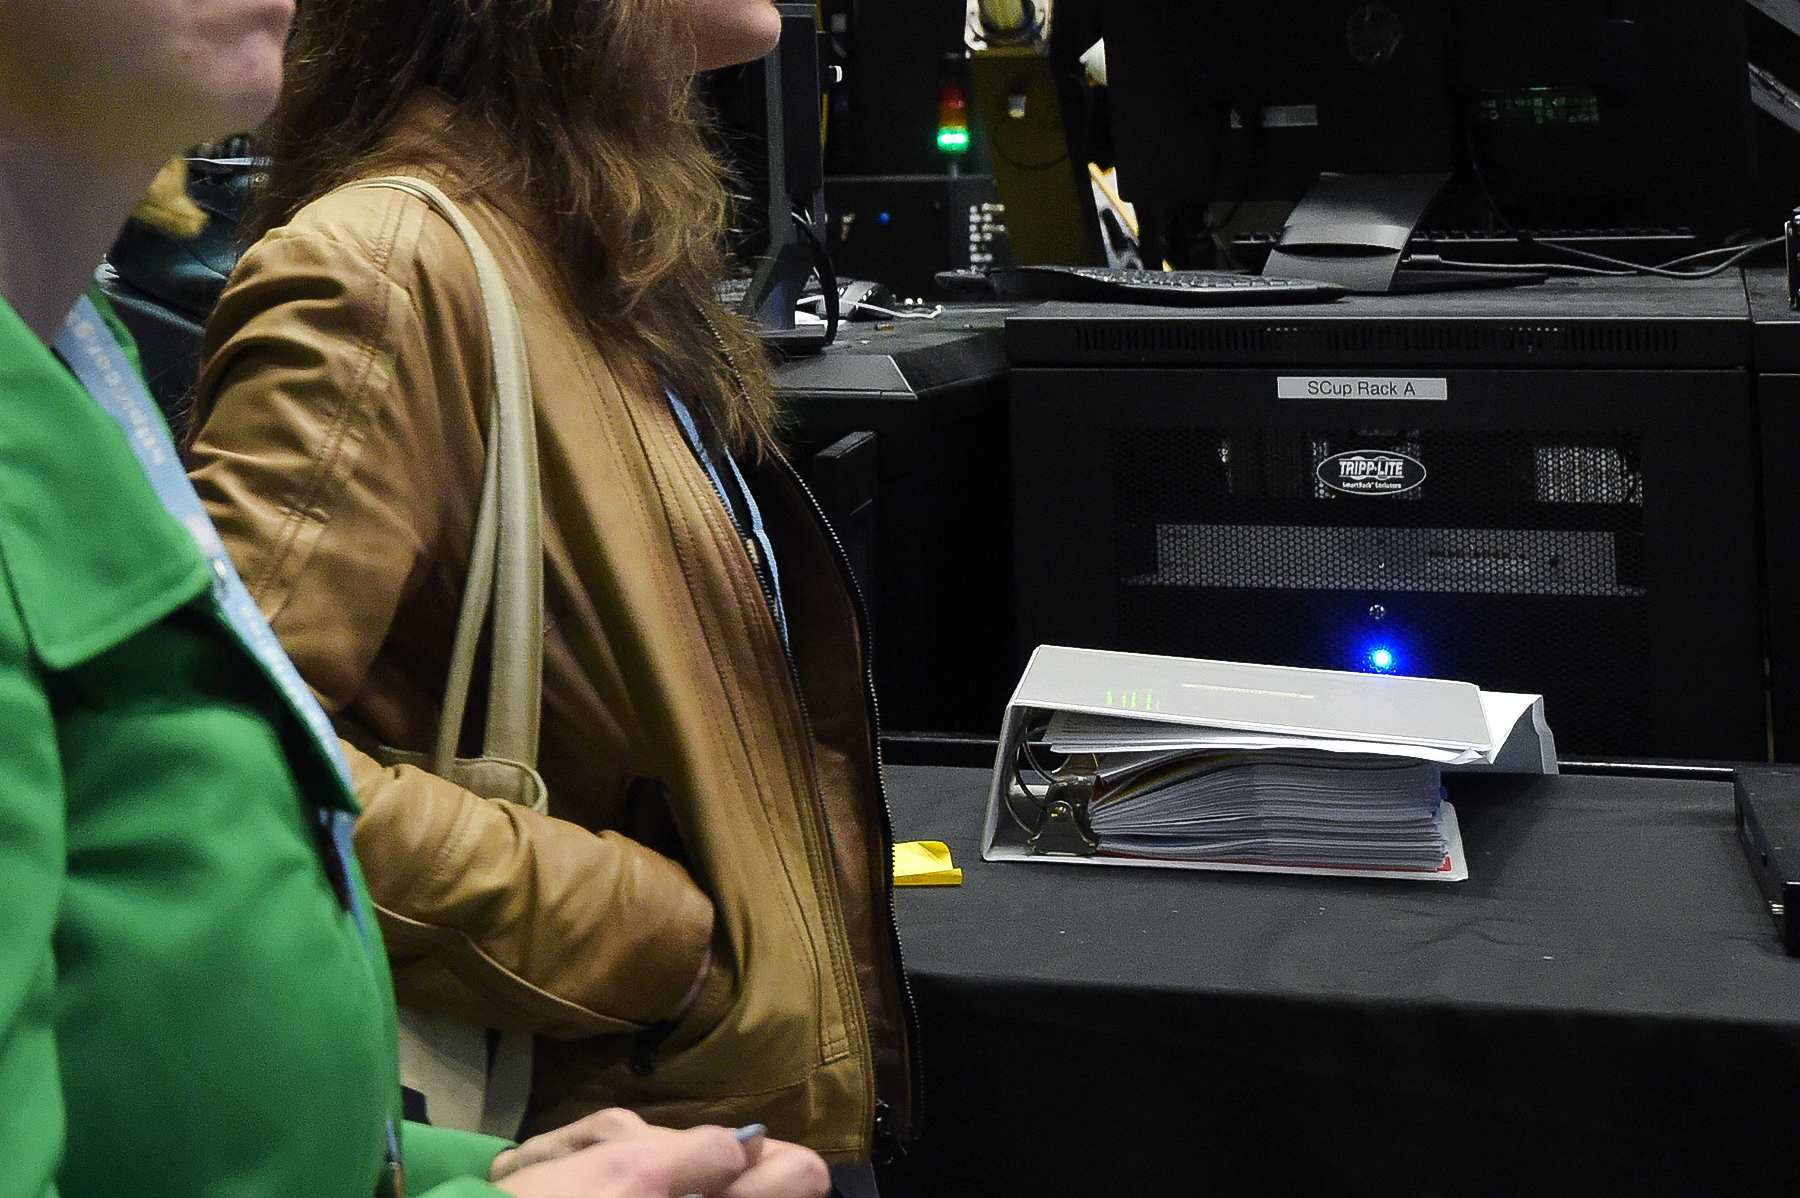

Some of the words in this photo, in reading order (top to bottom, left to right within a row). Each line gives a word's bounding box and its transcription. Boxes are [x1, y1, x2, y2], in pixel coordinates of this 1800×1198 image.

[1307, 381, 1352, 396] SCup
[1358, 382, 1398, 396] Rack
[1404, 382, 1416, 396] A
